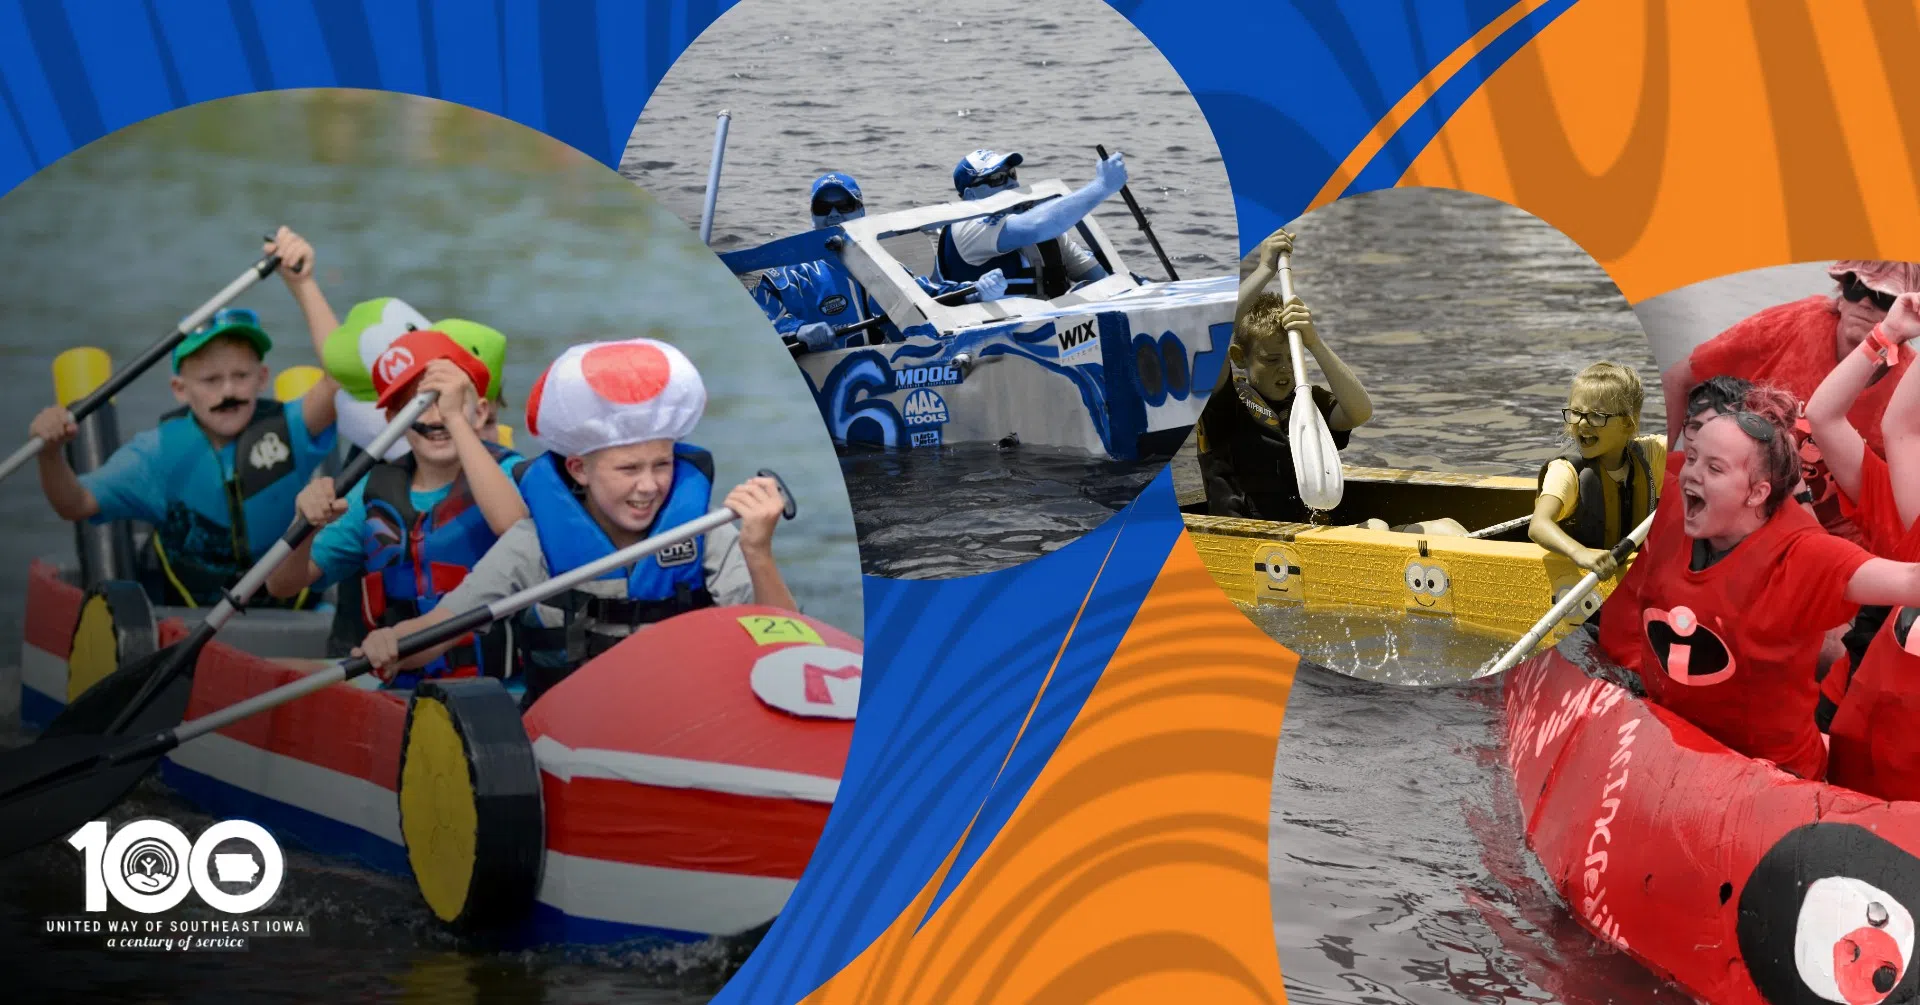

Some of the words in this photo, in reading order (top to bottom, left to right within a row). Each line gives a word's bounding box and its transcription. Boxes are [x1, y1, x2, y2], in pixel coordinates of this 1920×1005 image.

[1058, 319, 1097, 350] WIX
[383, 350, 413, 382] M
[895, 365, 958, 386] MOOG
[827, 354, 900, 447] 6
[905, 390, 945, 416] MAC
[906, 412, 947, 425] TOOLS
[754, 617, 805, 635] 21
